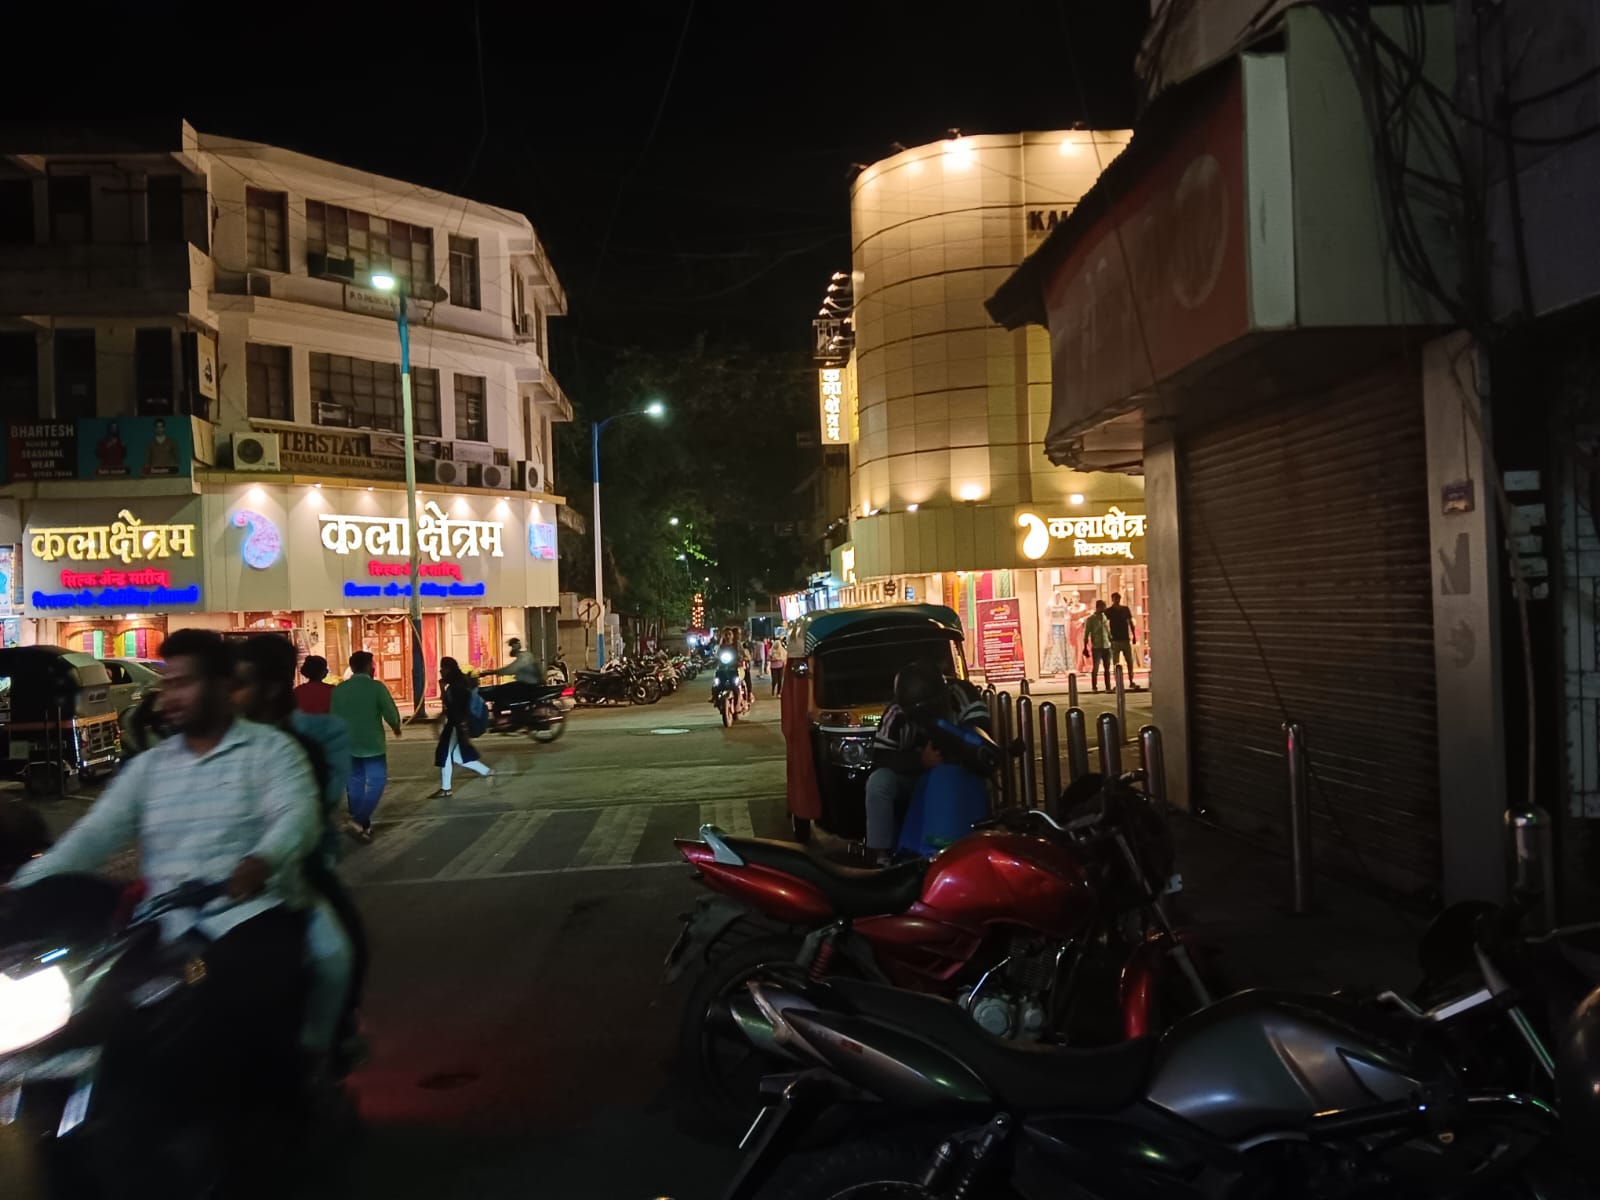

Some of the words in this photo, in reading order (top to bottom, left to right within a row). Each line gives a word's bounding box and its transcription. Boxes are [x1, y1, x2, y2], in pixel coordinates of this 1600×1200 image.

[1029, 210, 1068, 231] KA
[10, 424, 75, 438] BHARTESH
[255, 428, 362, 457] TERSTAT
[21, 449, 65, 459] SEASONAL
[31, 459, 56, 470] WEAR
[319, 501, 503, 562] कलाक्षेत्रम
[1047, 506, 1147, 541] कलाक्षेत्र
[30, 509, 195, 563] कलाक्षेत्रम
[60, 568, 97, 587] सिल्क
